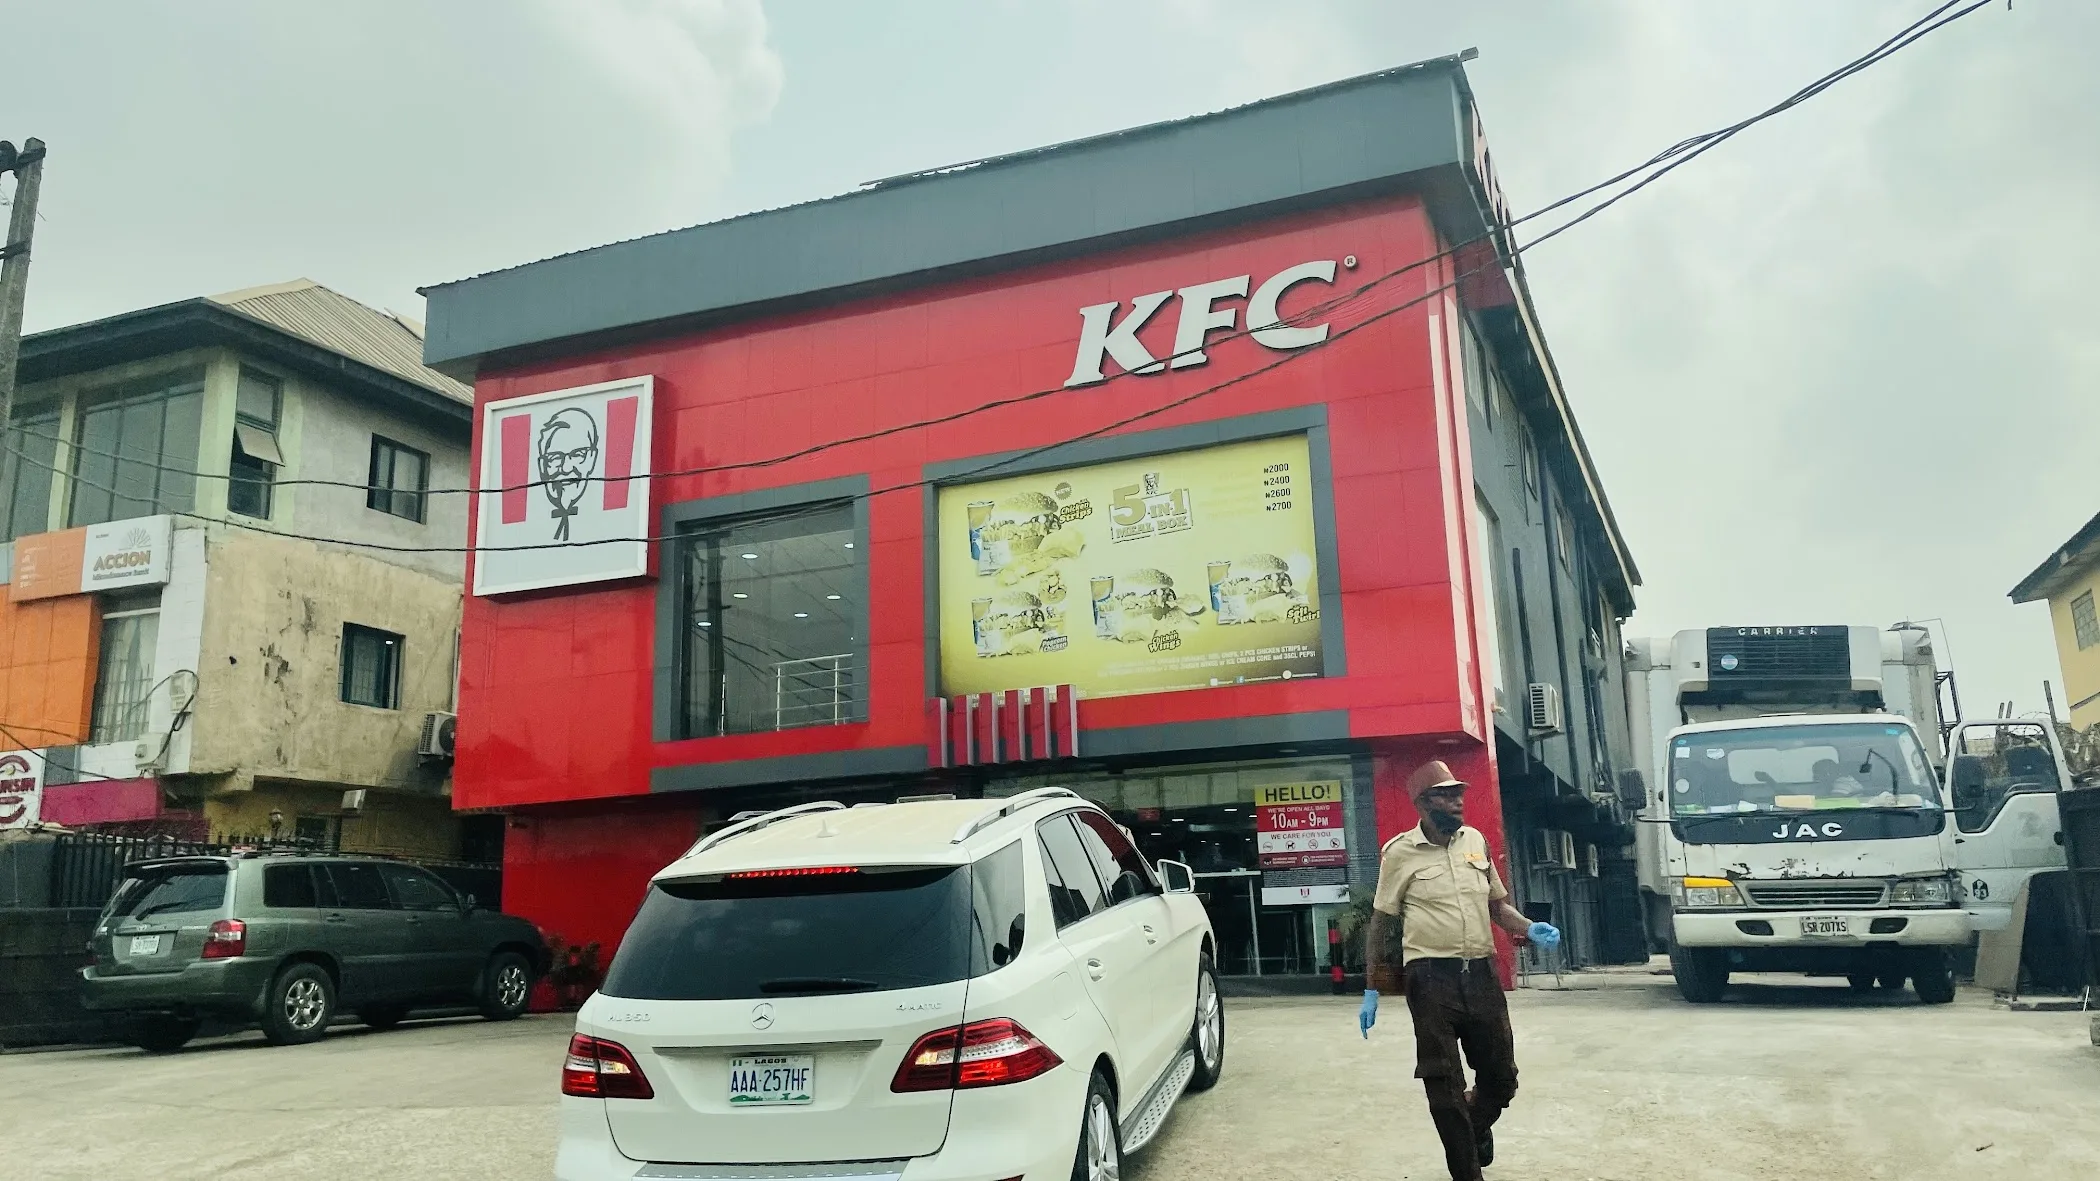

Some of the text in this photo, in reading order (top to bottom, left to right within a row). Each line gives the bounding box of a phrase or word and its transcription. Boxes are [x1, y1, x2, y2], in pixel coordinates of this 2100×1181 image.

[1063, 259, 1337, 387] KFC
[1116, 516, 1188, 539] MEAL BOX
[93, 550, 151, 571] ACCION
[1738, 627, 1818, 636] CARRIER
[1148, 639, 1181, 653] Wings
[1256, 647, 1280, 655] CHICKEN
[1281, 645, 1301, 653] STRIPS
[1256, 654, 1272, 662] CONE
[1265, 785, 1331, 802] HELLO!
[1773, 822, 1843, 838] JAC
